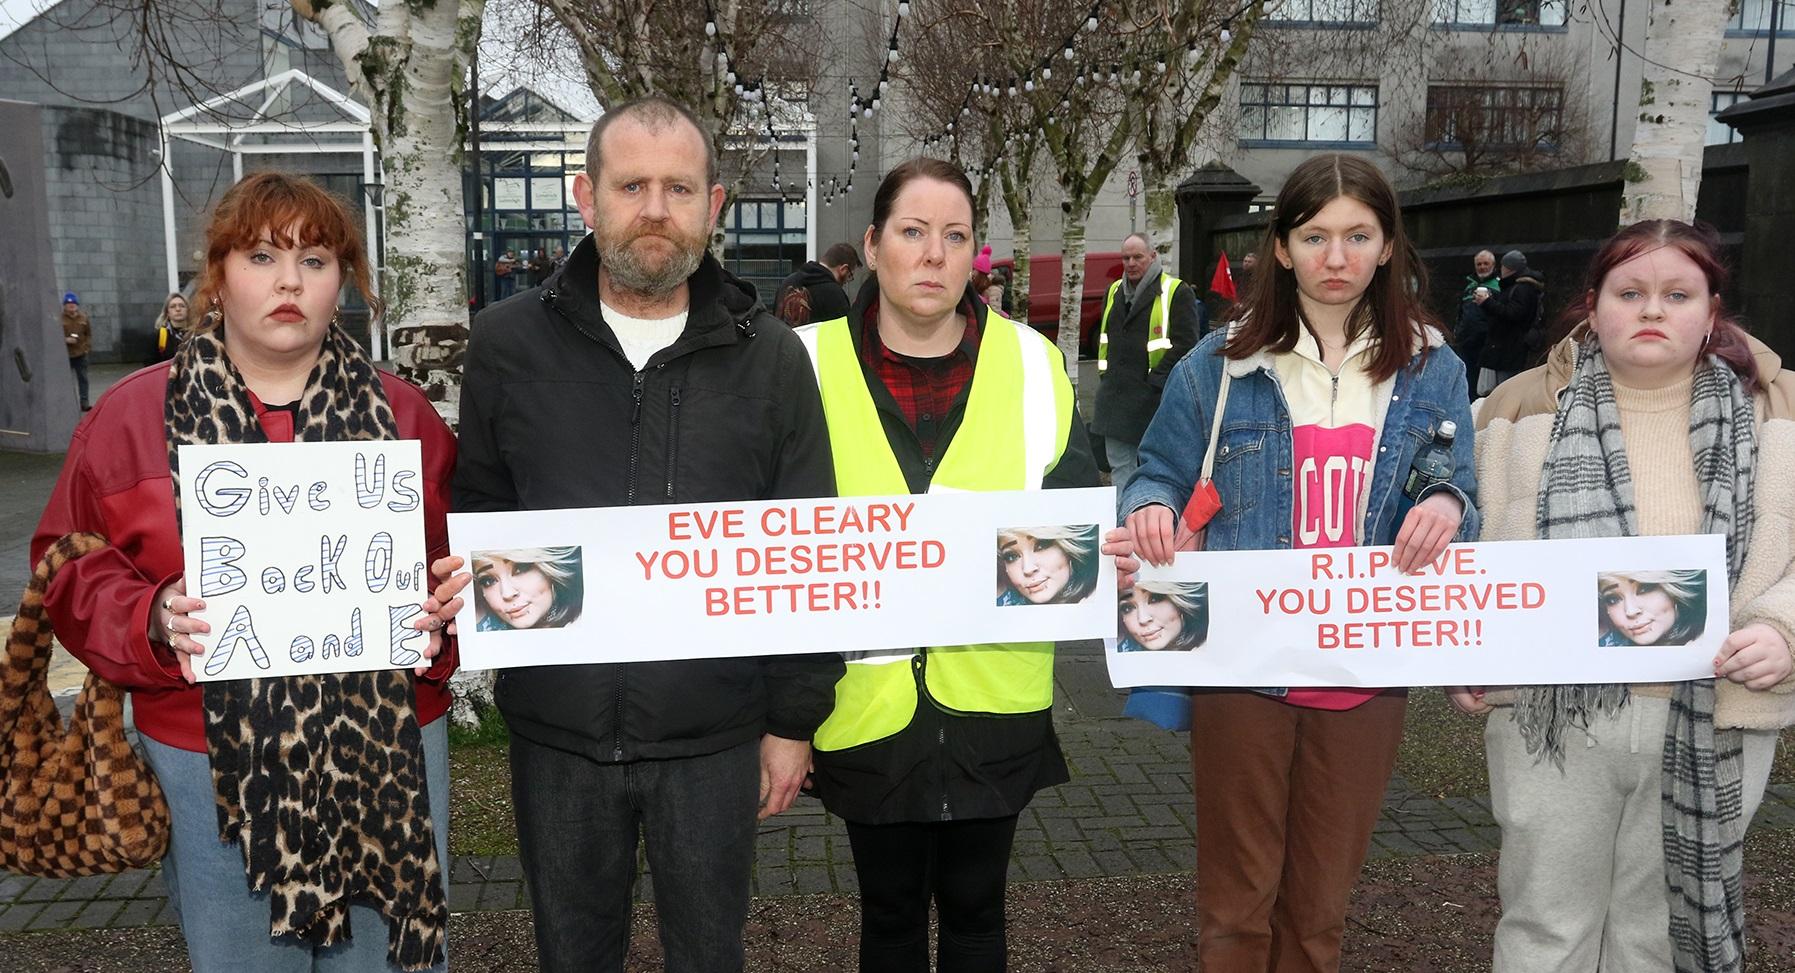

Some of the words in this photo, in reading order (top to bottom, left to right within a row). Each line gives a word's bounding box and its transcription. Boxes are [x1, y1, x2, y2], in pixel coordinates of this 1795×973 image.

[195, 460, 331, 518] Give
[354, 452, 420, 512] Us
[669, 509, 746, 541] EVE
[761, 502, 915, 537] CLEARY
[365, 531, 425, 594] Our
[635, 548, 719, 580] YOU
[736, 540, 946, 577] DESERVED
[1411, 549, 1487, 576] VE.
[705, 580, 881, 616] BETTER!!
[1256, 588, 1331, 615] YOU
[1346, 582, 1546, 614] DESERVED
[204, 604, 271, 677] A
[289, 606, 364, 663] and
[388, 603, 423, 666] E
[1317, 619, 1482, 649] BETTER!!
